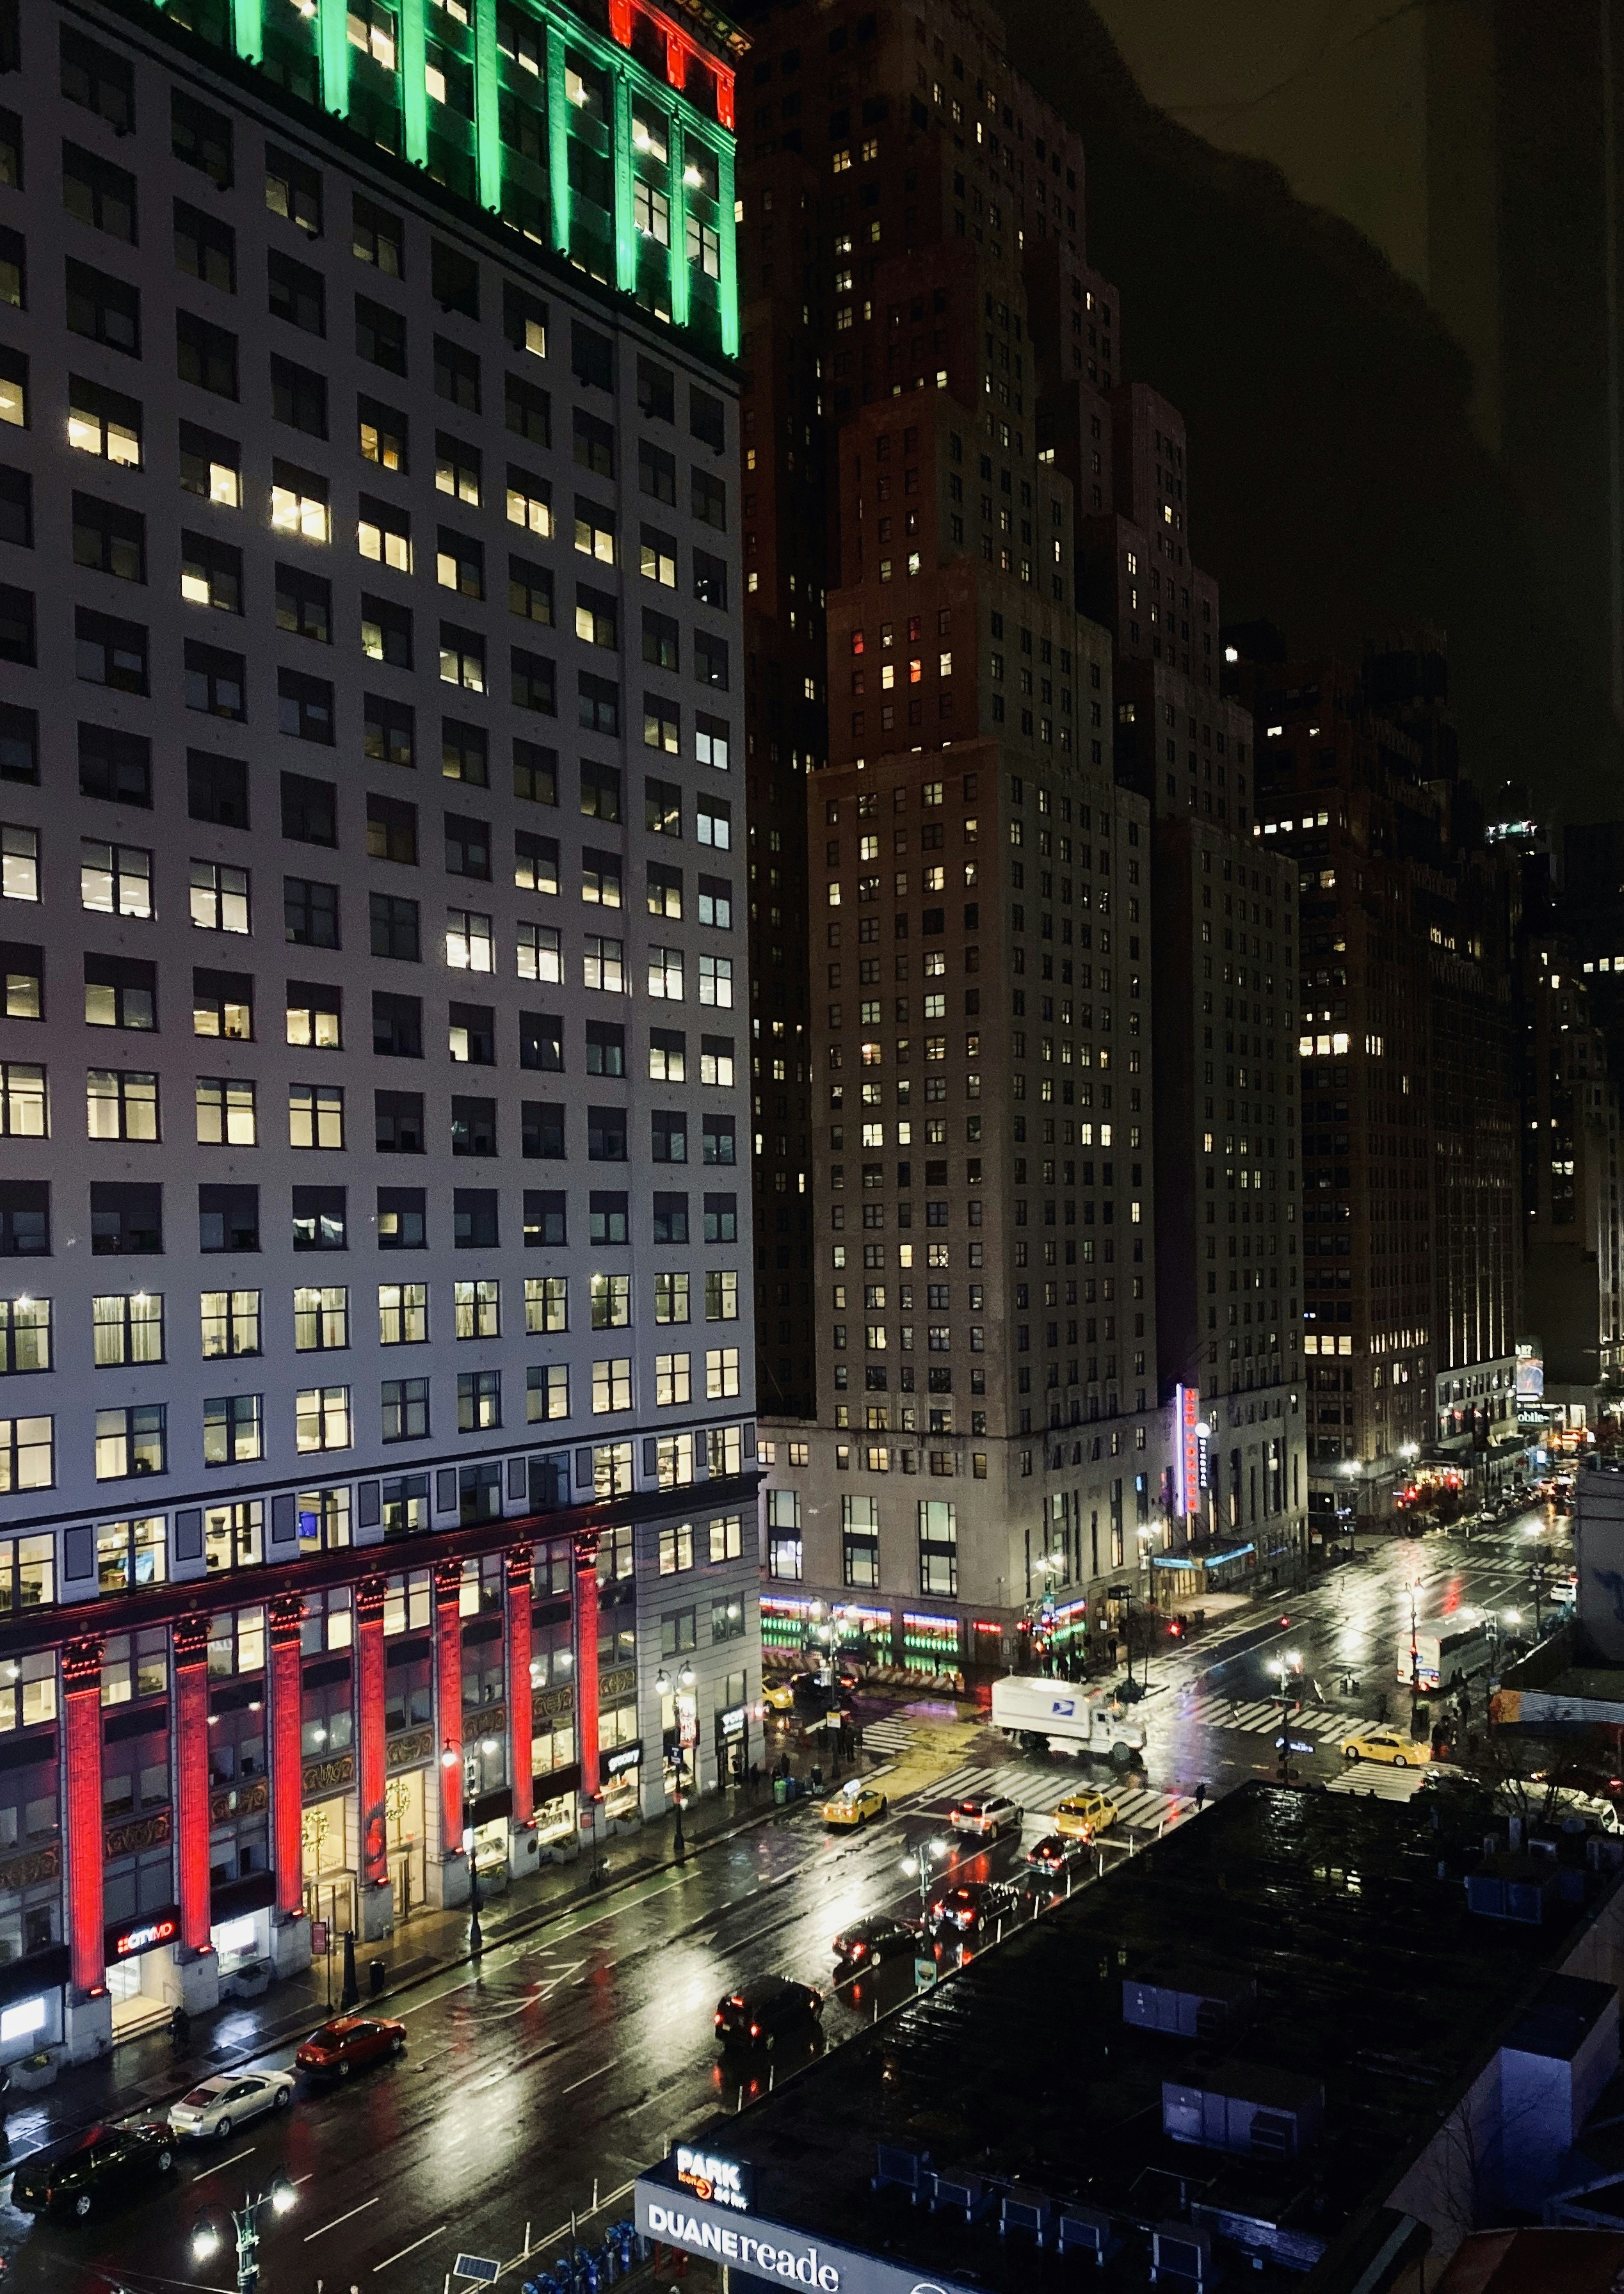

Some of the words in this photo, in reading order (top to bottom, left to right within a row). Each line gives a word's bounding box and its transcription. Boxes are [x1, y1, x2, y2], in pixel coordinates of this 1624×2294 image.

[1185, 1390, 1196, 1427] NEW
[1517, 1411, 1544, 1422] obile
[1186, 1433, 1197, 1511] YORKER
[677, 2148, 741, 2190] PARK
